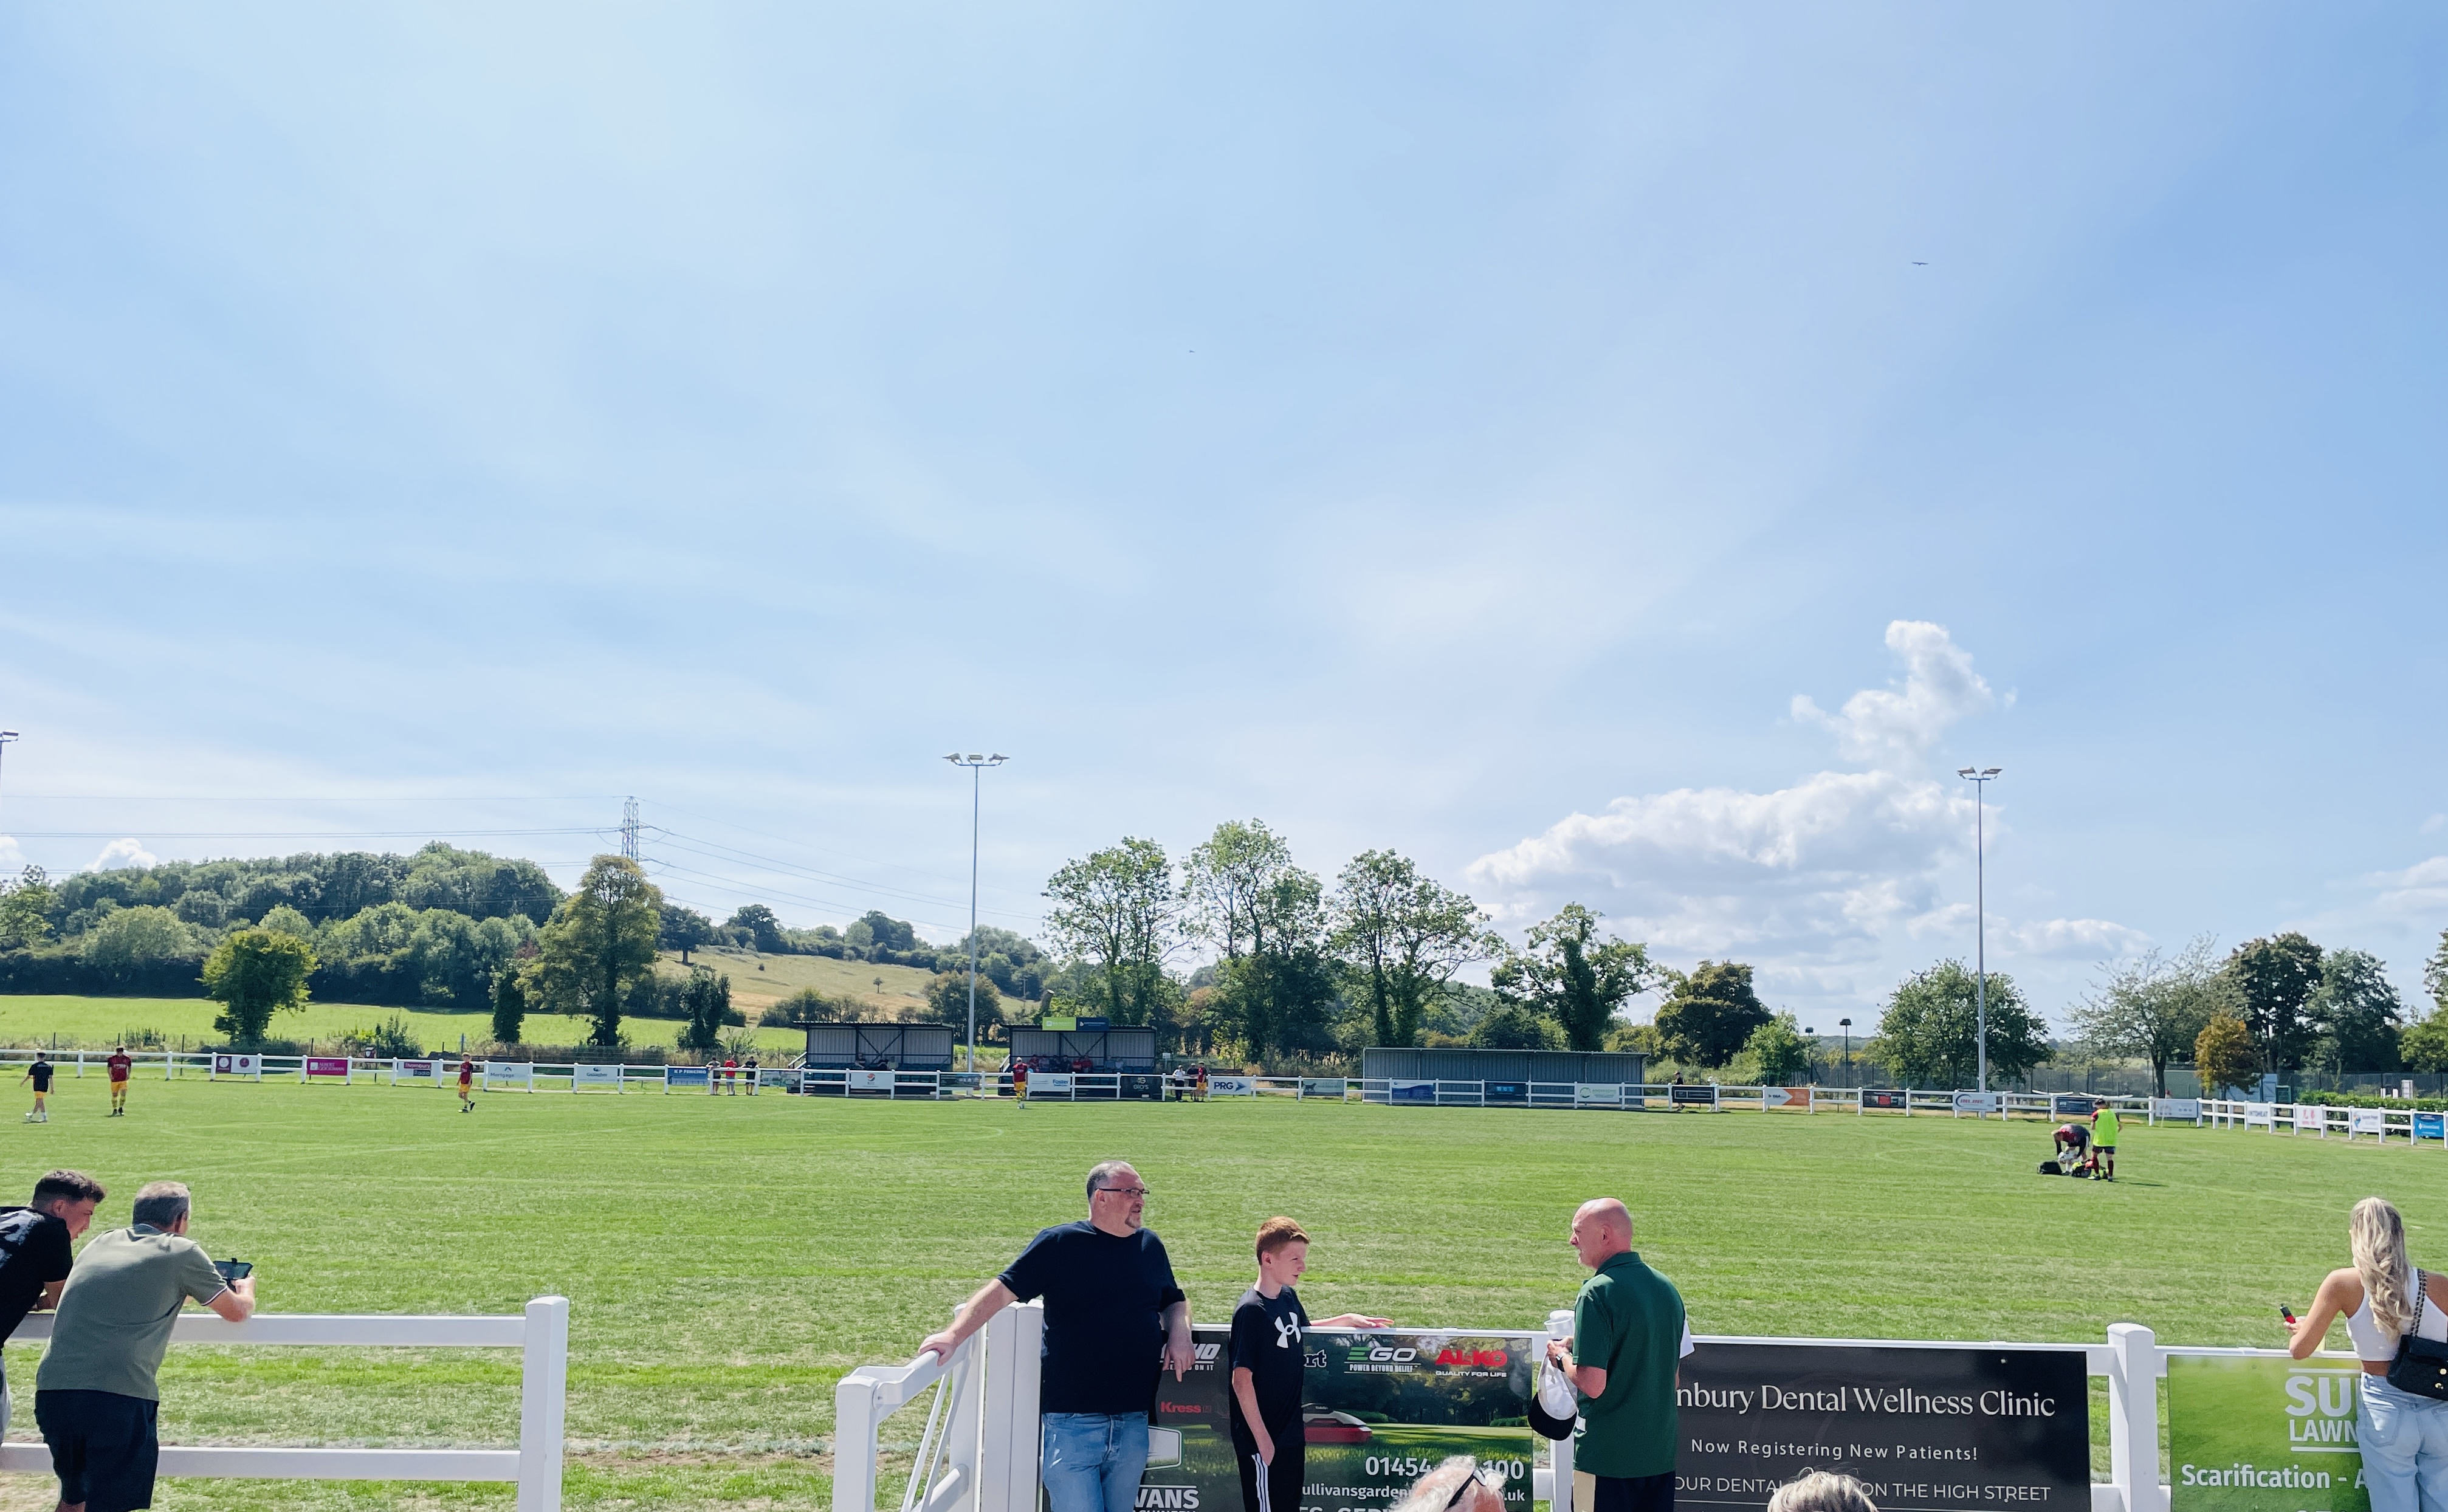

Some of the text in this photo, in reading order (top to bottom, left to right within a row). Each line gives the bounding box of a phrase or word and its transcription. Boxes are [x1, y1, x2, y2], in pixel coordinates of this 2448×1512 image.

[1347, 1347, 1417, 1361] EGO
[1435, 1349, 1507, 1367] AL-KO
[1161, 1401, 1202, 1413] Kress
[1676, 1382, 2055, 1417] nbury Dental Wellness Clinic
[1691, 1438, 1978, 1460] Now Registering New Patients!
[1365, 1456, 1432, 1477] 01454
[2181, 1463, 2331, 1489] Scarification
[1135, 1489, 1200, 1509] VANS
[1675, 1476, 1711, 1491] OUR
[1892, 1483, 1928, 1498] THE
[1934, 1484, 1979, 1499] HIGH
[1984, 1485, 2051, 1502] STREET
